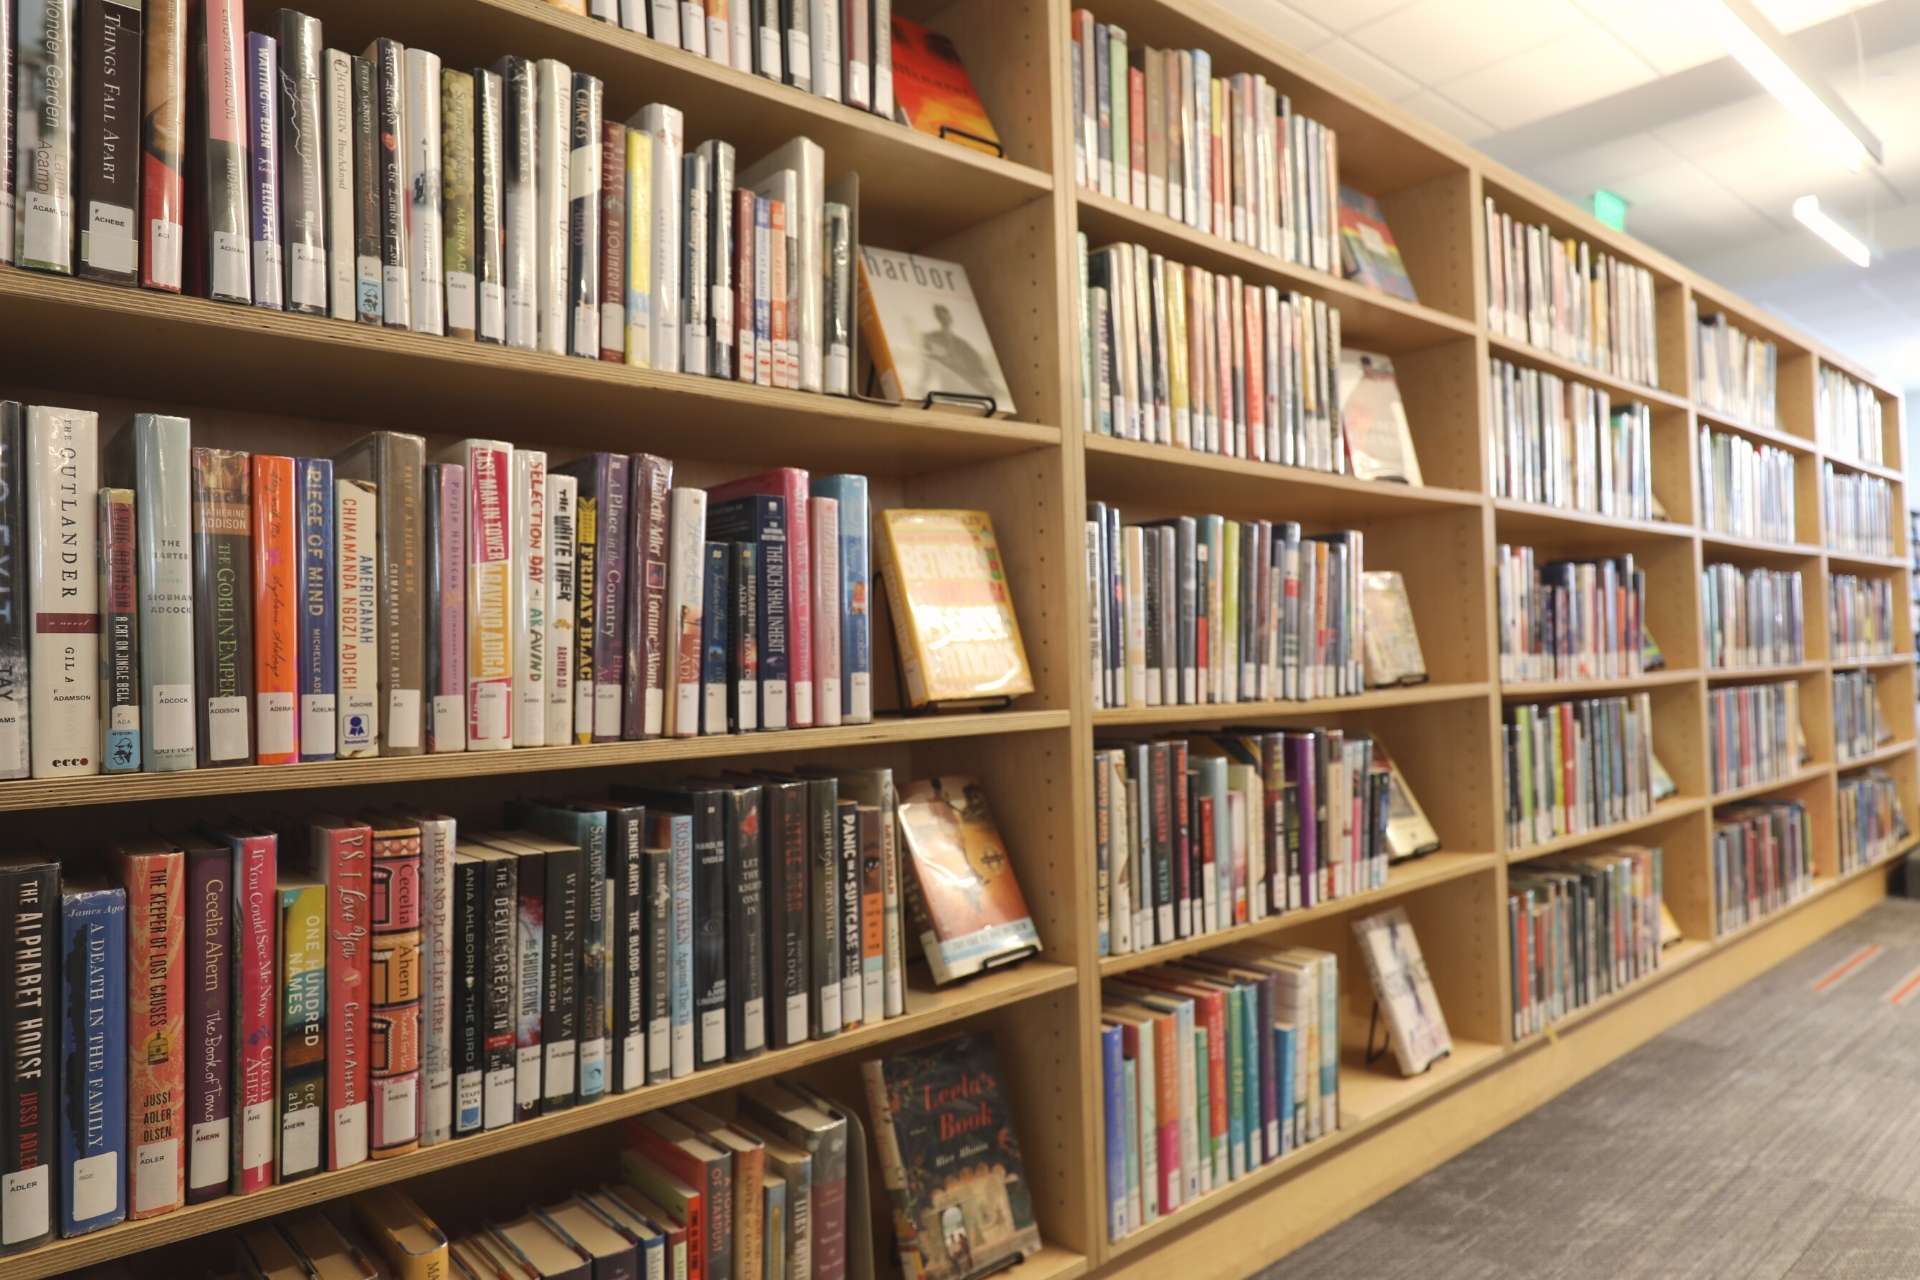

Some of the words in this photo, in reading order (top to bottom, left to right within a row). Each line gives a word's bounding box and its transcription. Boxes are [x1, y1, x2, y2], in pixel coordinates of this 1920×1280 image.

[103, 13, 121, 75] THINGS
[258, 47, 270, 99] WAITING
[44, 64, 63, 128] Garden
[103, 83, 121, 123] FALL
[261, 117, 272, 148] EDEN
[103, 128, 121, 183] APART
[94, 216, 125, 227] ACHEBE
[863, 246, 956, 291] harbor
[307, 468, 323, 526] PIECE
[479, 481, 498, 505] MAN
[482, 507, 500, 519] IN
[529, 462, 543, 549] SELECTION
[608, 494, 622, 534] Place
[218, 544, 231, 565] THE
[308, 534, 323, 558] OF
[342, 499, 357, 591] CHIMAMANDA
[484, 523, 505, 560] TOWER
[554, 515, 573, 557] WHITE
[766, 545, 783, 563] THE
[529, 555, 544, 584] DAY
[553, 562, 573, 602] TIGER
[580, 544, 594, 622] FRIDAY
[766, 565, 783, 586] RICH
[308, 567, 324, 617] MIND
[359, 556, 373, 643] AMERICANAH
[601, 570, 620, 638] Country
[767, 588, 784, 614] SHALL
[116, 624, 128, 638] CAT
[342, 597, 357, 638] NGOZI
[767, 616, 784, 653] INHERIT
[64, 647, 75, 670] GIL
[116, 641, 128, 651] ON
[313, 628, 321, 674] MICHELLE
[481, 632, 510, 676] ADIGA
[529, 608, 543, 682] ARAVIND
[116, 653, 128, 680] JINGLE
[251, 848, 267, 862] If
[590, 826, 603, 876] SALADIN
[628, 820, 639, 860] RENNIE
[843, 814, 856, 858] PANIC
[248, 863, 264, 891] You
[433, 832, 447, 885] THERE'S
[676, 821, 689, 894] ROSEMARY
[743, 858, 759, 868] LET
[19, 880, 38, 904] THE
[149, 868, 167, 889] THE
[399, 864, 415, 925] Cecelia
[465, 868, 474, 899] ANIA
[495, 868, 507, 888] THE
[628, 863, 639, 896] AIRTH
[149, 892, 167, 934] KEEPER
[205, 879, 224, 937] Cecelia
[249, 892, 267, 934] Could
[335, 887, 366, 921] Love
[432, 891, 445, 911] NO
[564, 873, 577, 941] WITHIN
[590, 878, 604, 922] AHMED
[844, 881, 858, 949] SUITCASE
[90, 923, 104, 934] A
[305, 915, 320, 951] ONE
[432, 913, 445, 958] PLACE
[494, 897, 509, 944] DEVIL
[629, 910, 640, 931] THE
[676, 898, 690, 945] AITKEN
[15, 912, 42, 1008] ALPHABET
[149, 937, 167, 951] OF
[254, 934, 269, 959] See
[333, 926, 366, 961] You
[465, 905, 475, 978] AHLBORN
[549, 934, 557, 960] ANIA
[89, 938, 104, 1000] DEATH
[149, 955, 167, 980] LOST
[205, 941, 223, 992] Ahern
[258, 961, 273, 983] Me
[288, 953, 303, 1015] NAMES
[399, 945, 414, 998] Ahern
[432, 962, 445, 995] LIKE
[493, 953, 508, 1003] CREPT
[521, 952, 539, 1016] SHUDDERING
[562, 949, 575, 1006] THESE
[629, 935, 641, 1022] BLOOD-DIMMED
[149, 984, 168, 1027] CAUSES
[257, 986, 272, 1018] Now
[304, 961, 320, 1047] HUNDRED
[465, 992, 474, 1023] THE
[549, 963, 557, 1012] AHLBORN
[88, 1007, 104, 1027] IN
[206, 1010, 221, 1034] The
[343, 1001, 360, 1057] CECELIA
[431, 1002, 445, 1035] HERE
[494, 1013, 508, 1030] IN
[15, 1017, 42, 1081] HOUSE
[88, 1032, 104, 1072] THE
[205, 1037, 222, 1072] Book
[465, 1028, 474, 1062] BIRD
[205, 1073, 222, 1085] of
[88, 1079, 104, 1148] FAMILY
[143, 1091, 171, 1108] JUSSI
[143, 1126, 172, 1143] OLSEN
[195, 1133, 220, 1143] AHERN
[284, 1121, 305, 1130] AHERN
[939, 1101, 992, 1142] Book
[140, 1155, 165, 1165] ADLER
[10, 1181, 38, 1193] ADLER
